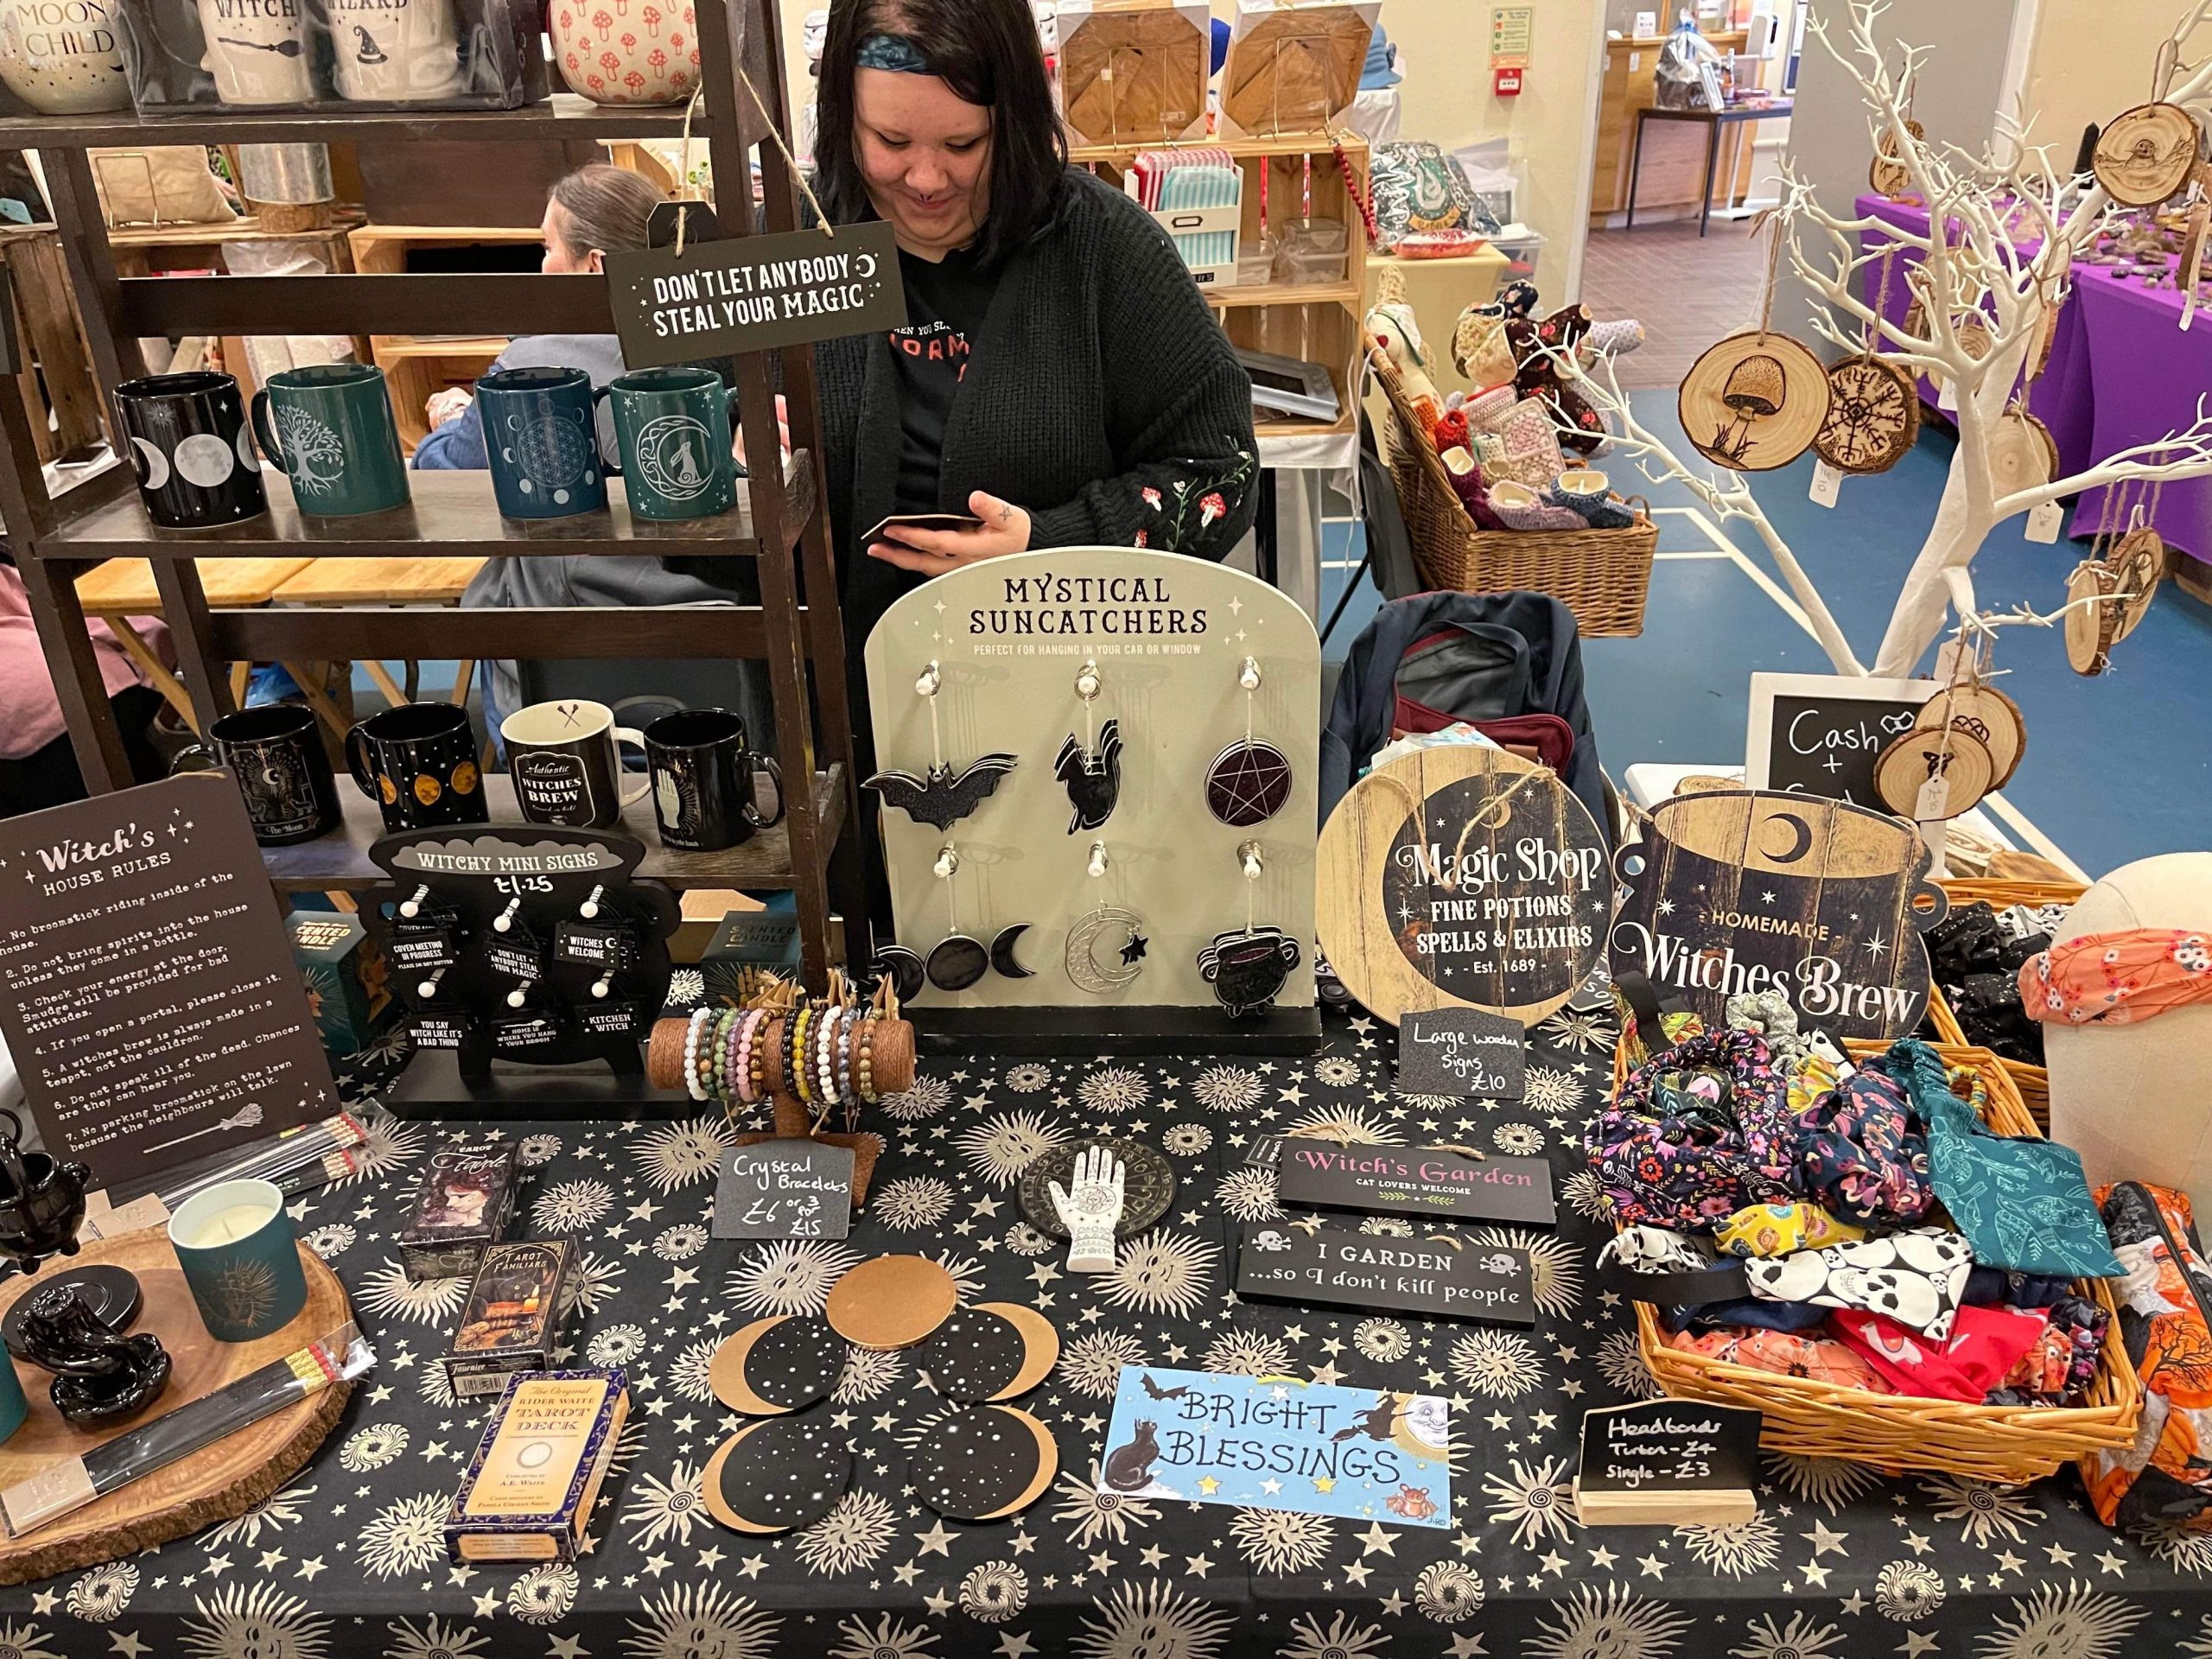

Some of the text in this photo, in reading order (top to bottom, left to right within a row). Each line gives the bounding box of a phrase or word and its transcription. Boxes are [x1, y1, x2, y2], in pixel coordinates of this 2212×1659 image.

[16, 1, 108, 26] MOON
[25, 29, 114, 56] CHILD
[653, 253, 849, 304] DON'T LET ANYBODY
[653, 283, 864, 338] STEAL YOUR MAGIC
[1004, 572, 1171, 604] MYSTICAL
[969, 609, 1208, 635] SUNCATCHERS
[974, 645, 1201, 656] PERFECT FOR HANGING IN YOUR CAR OR WINDOW
[1789, 709, 1878, 754] Cash
[1822, 753, 1843, 774] +
[522, 777, 582, 790] WITCHES
[527, 790, 578, 804] BREW
[35, 823, 155, 873] Witch's
[42, 851, 172, 897] HOUSE RULES
[417, 852, 599, 872] WITCHY MINI SIGNS
[1395, 837, 1601, 894] Magic Shop
[494, 875, 553, 895] £1.25
[9, 873, 233, 940] No broomstick riding inside of the
[1431, 895, 1572, 923] FINE POTIONS
[1712, 910, 1830, 942] HOMEMADE
[5, 904, 248, 979] 2. Do not bring spirits into the house
[393, 944, 415, 953] COVEN
[568, 946, 605, 959] WELCOME
[570, 936, 603, 949] WITCHES
[1416, 925, 1592, 955] SPELLS & ELIXIRS
[10, 972, 54, 989] unless
[56, 962, 86, 976] they
[91, 952, 119, 966] come
[124, 947, 137, 957] in
[152, 931, 198, 948] bottle.
[410, 950, 442, 960] PROGRESS
[1473, 959, 1535, 974] Est. 1689
[17, 945, 228, 1012] 3. Check your energy at the door.
[512, 968, 537, 979] MAGIC
[1611, 921, 1790, 1001] Witches
[1796, 956, 1919, 1023] Brew
[22, 953, 230, 1023] Smudge will be provided for bad
[26, 1010, 92, 1034] attitudes.
[35, 1046, 48, 1055] 4.
[49, 1039, 66, 1051] If
[70, 1033, 91, 1047] you
[95, 1023, 124, 1038] open
[138, 1004, 183, 1026] portal,
[187, 991, 226, 1010] please
[230, 981, 262, 995] close
[265, 974, 282, 984] it.
[420, 1020, 435, 1029] YOU
[589, 1014, 631, 1024] KITCHEN
[595, 1022, 629, 1032] WITCH
[1414, 1022, 1468, 1054] Large
[1471, 1071, 1506, 1091] £10
[734, 1155, 810, 1191] Crystal
[1295, 1150, 1408, 1176] Witch's
[1419, 1161, 1533, 1187] Garden
[1356, 1178, 1471, 1196] CAT LOVERS WELCOME
[741, 1198, 780, 1224] £6
[808, 1196, 819, 1206] 3
[790, 1218, 822, 1236] £15
[493, 1261, 548, 1273] FAMILIARS
[505, 1252, 543, 1262] TAROT
[1318, 1243, 1452, 1272] I GARDEN
[1332, 1271, 1387, 1291] don't
[1397, 1277, 1434, 1295] kill
[1444, 1286, 1521, 1307] people
[516, 1408, 590, 1417] TAROT
[1178, 1391, 1338, 1435] BRIGHT
[514, 1421, 580, 1431] DECK
[1158, 1430, 1401, 1484] BLESSINGS
[1605, 1465, 1656, 1488] Single
